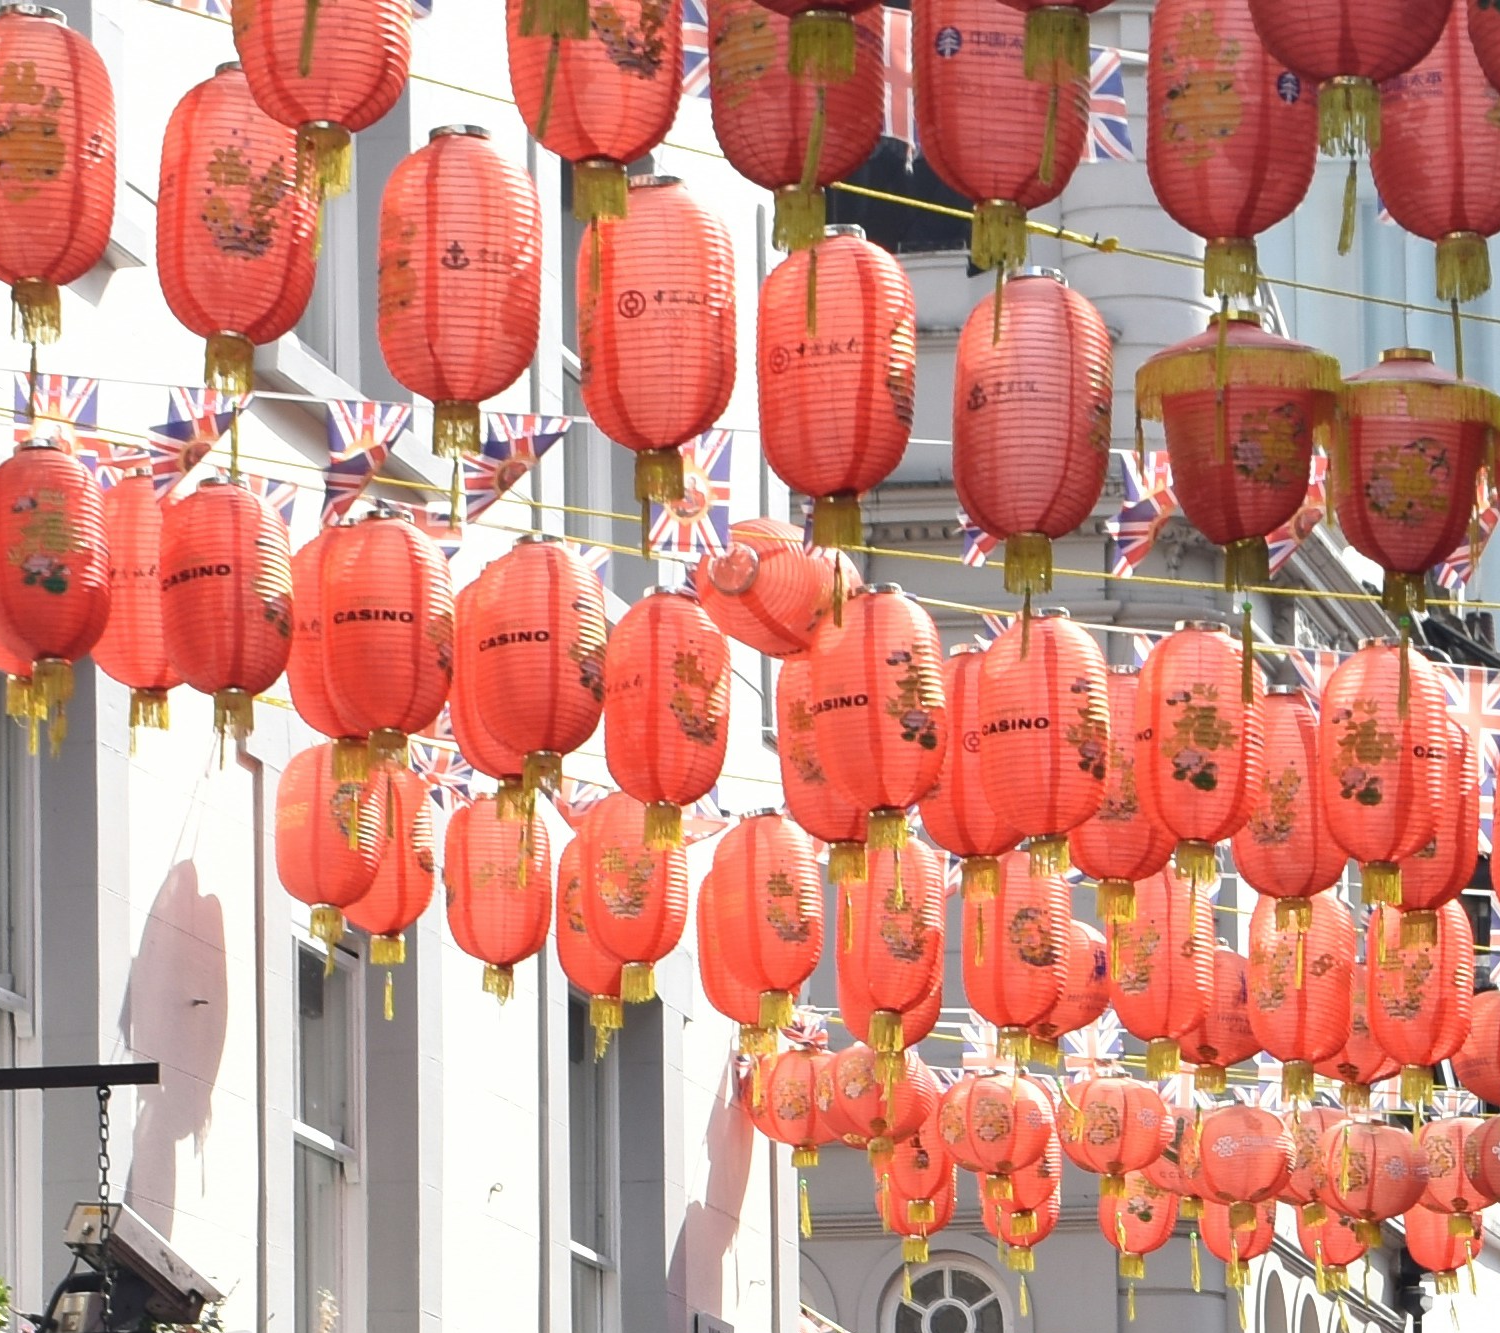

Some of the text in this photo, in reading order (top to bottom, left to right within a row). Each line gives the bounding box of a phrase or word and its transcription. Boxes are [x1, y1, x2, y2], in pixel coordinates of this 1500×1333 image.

[334, 610, 414, 624] CASINO
[479, 631, 550, 652] CASINO
[982, 716, 1050, 736] CASINO
